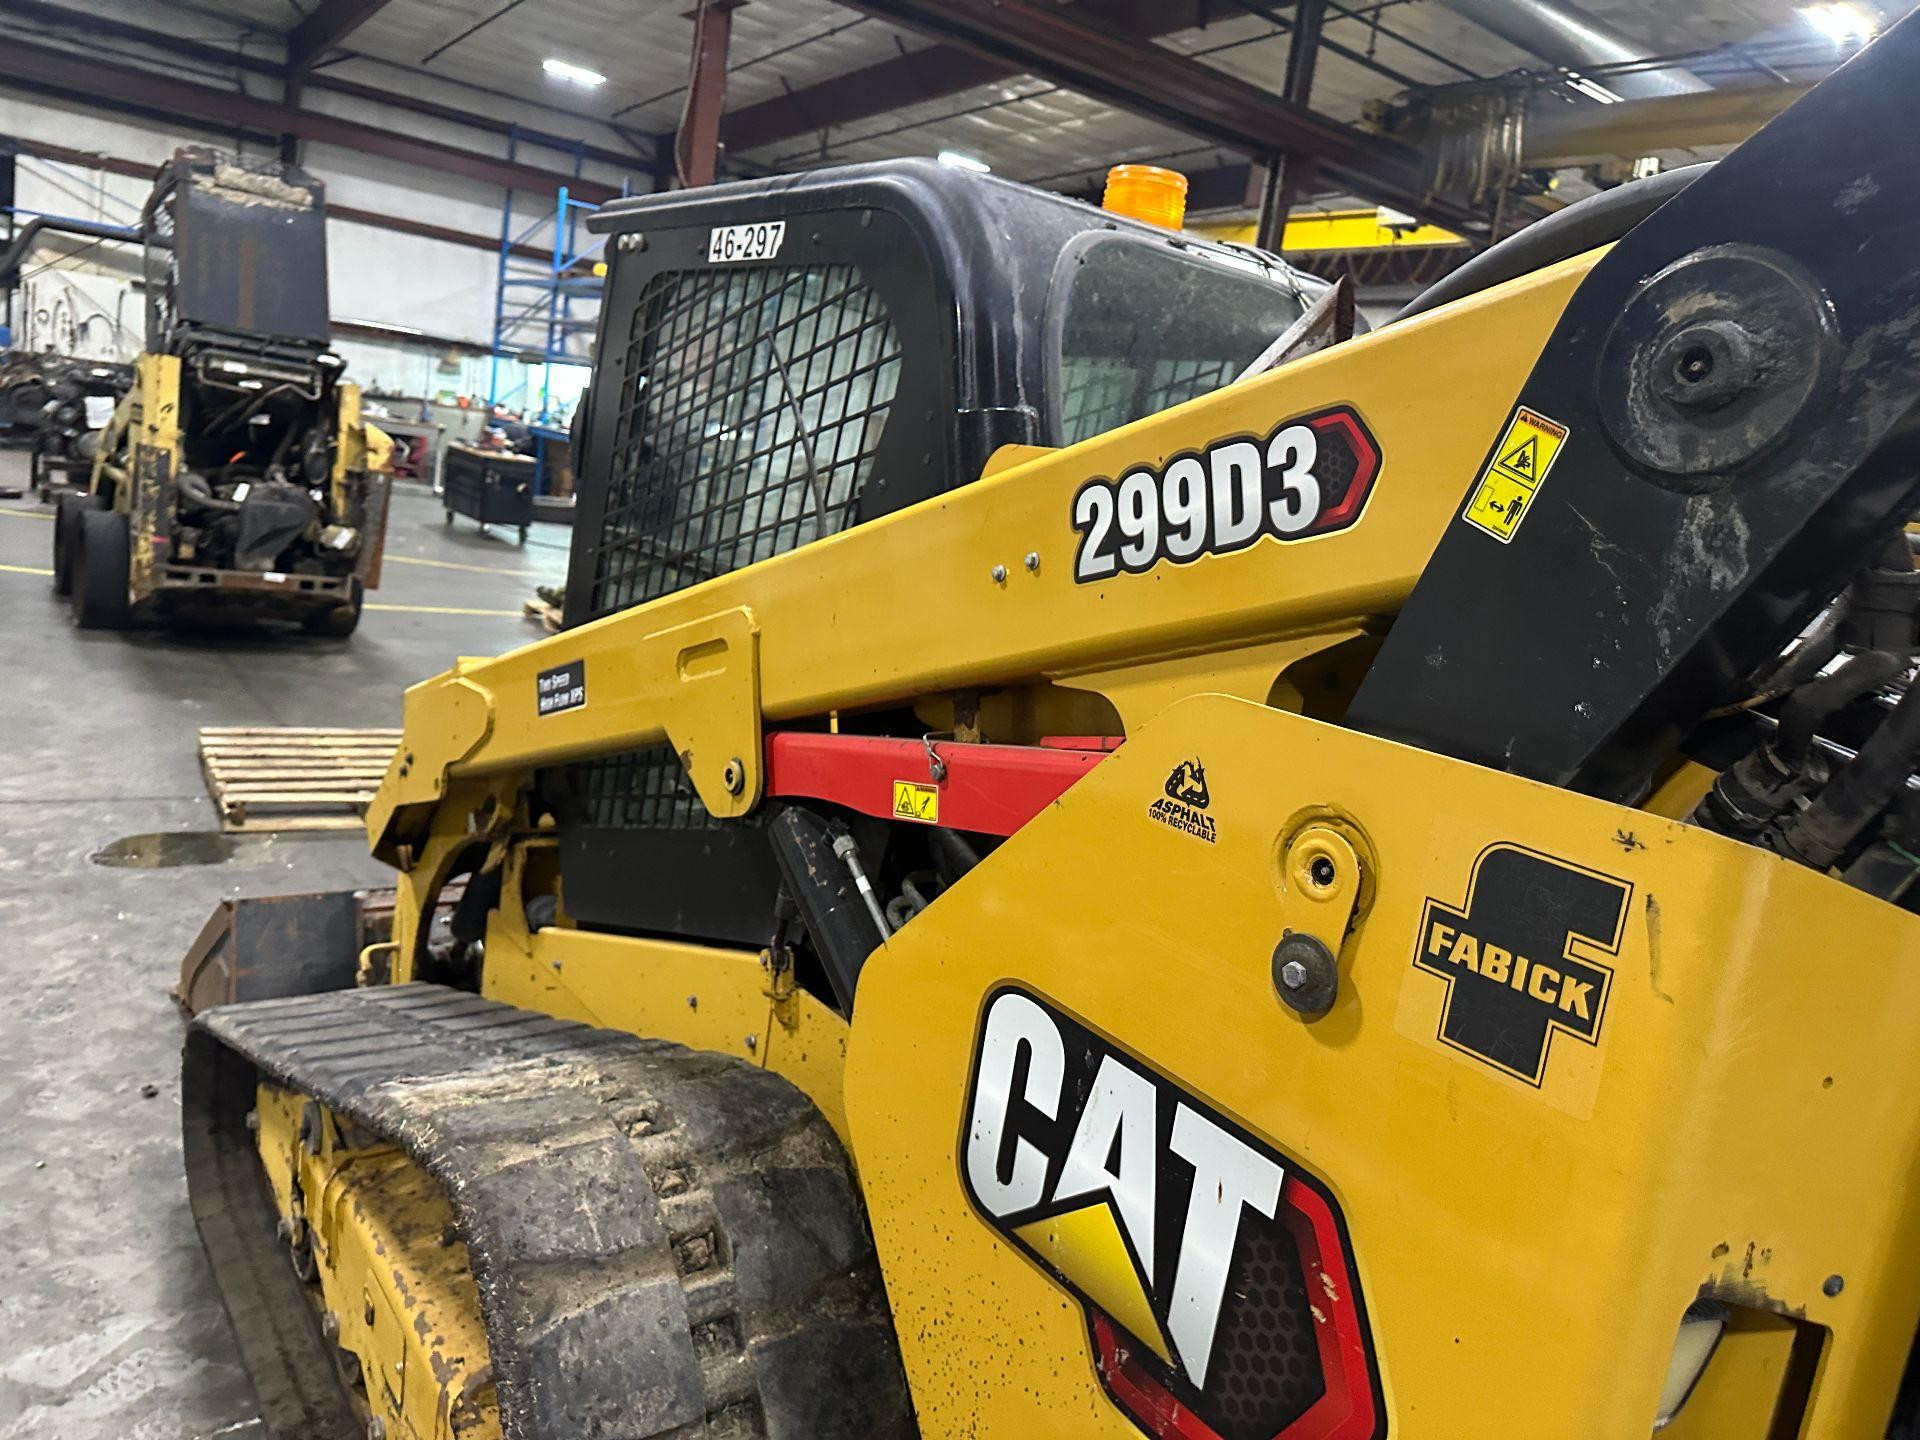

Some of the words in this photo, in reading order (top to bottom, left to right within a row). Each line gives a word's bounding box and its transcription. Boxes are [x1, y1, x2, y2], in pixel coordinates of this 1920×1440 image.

[713, 224, 781, 259] 46-297
[1529, 417, 1563, 439] WARNING
[1076, 425, 1320, 577] 299D3
[1148, 808, 1167, 823] 100%
[1168, 815, 1216, 843] RECYCLABLE
[1151, 799, 1215, 832] ASPHALT
[1428, 921, 1594, 1021] FABICK
[967, 994, 1284, 1391] CAT
